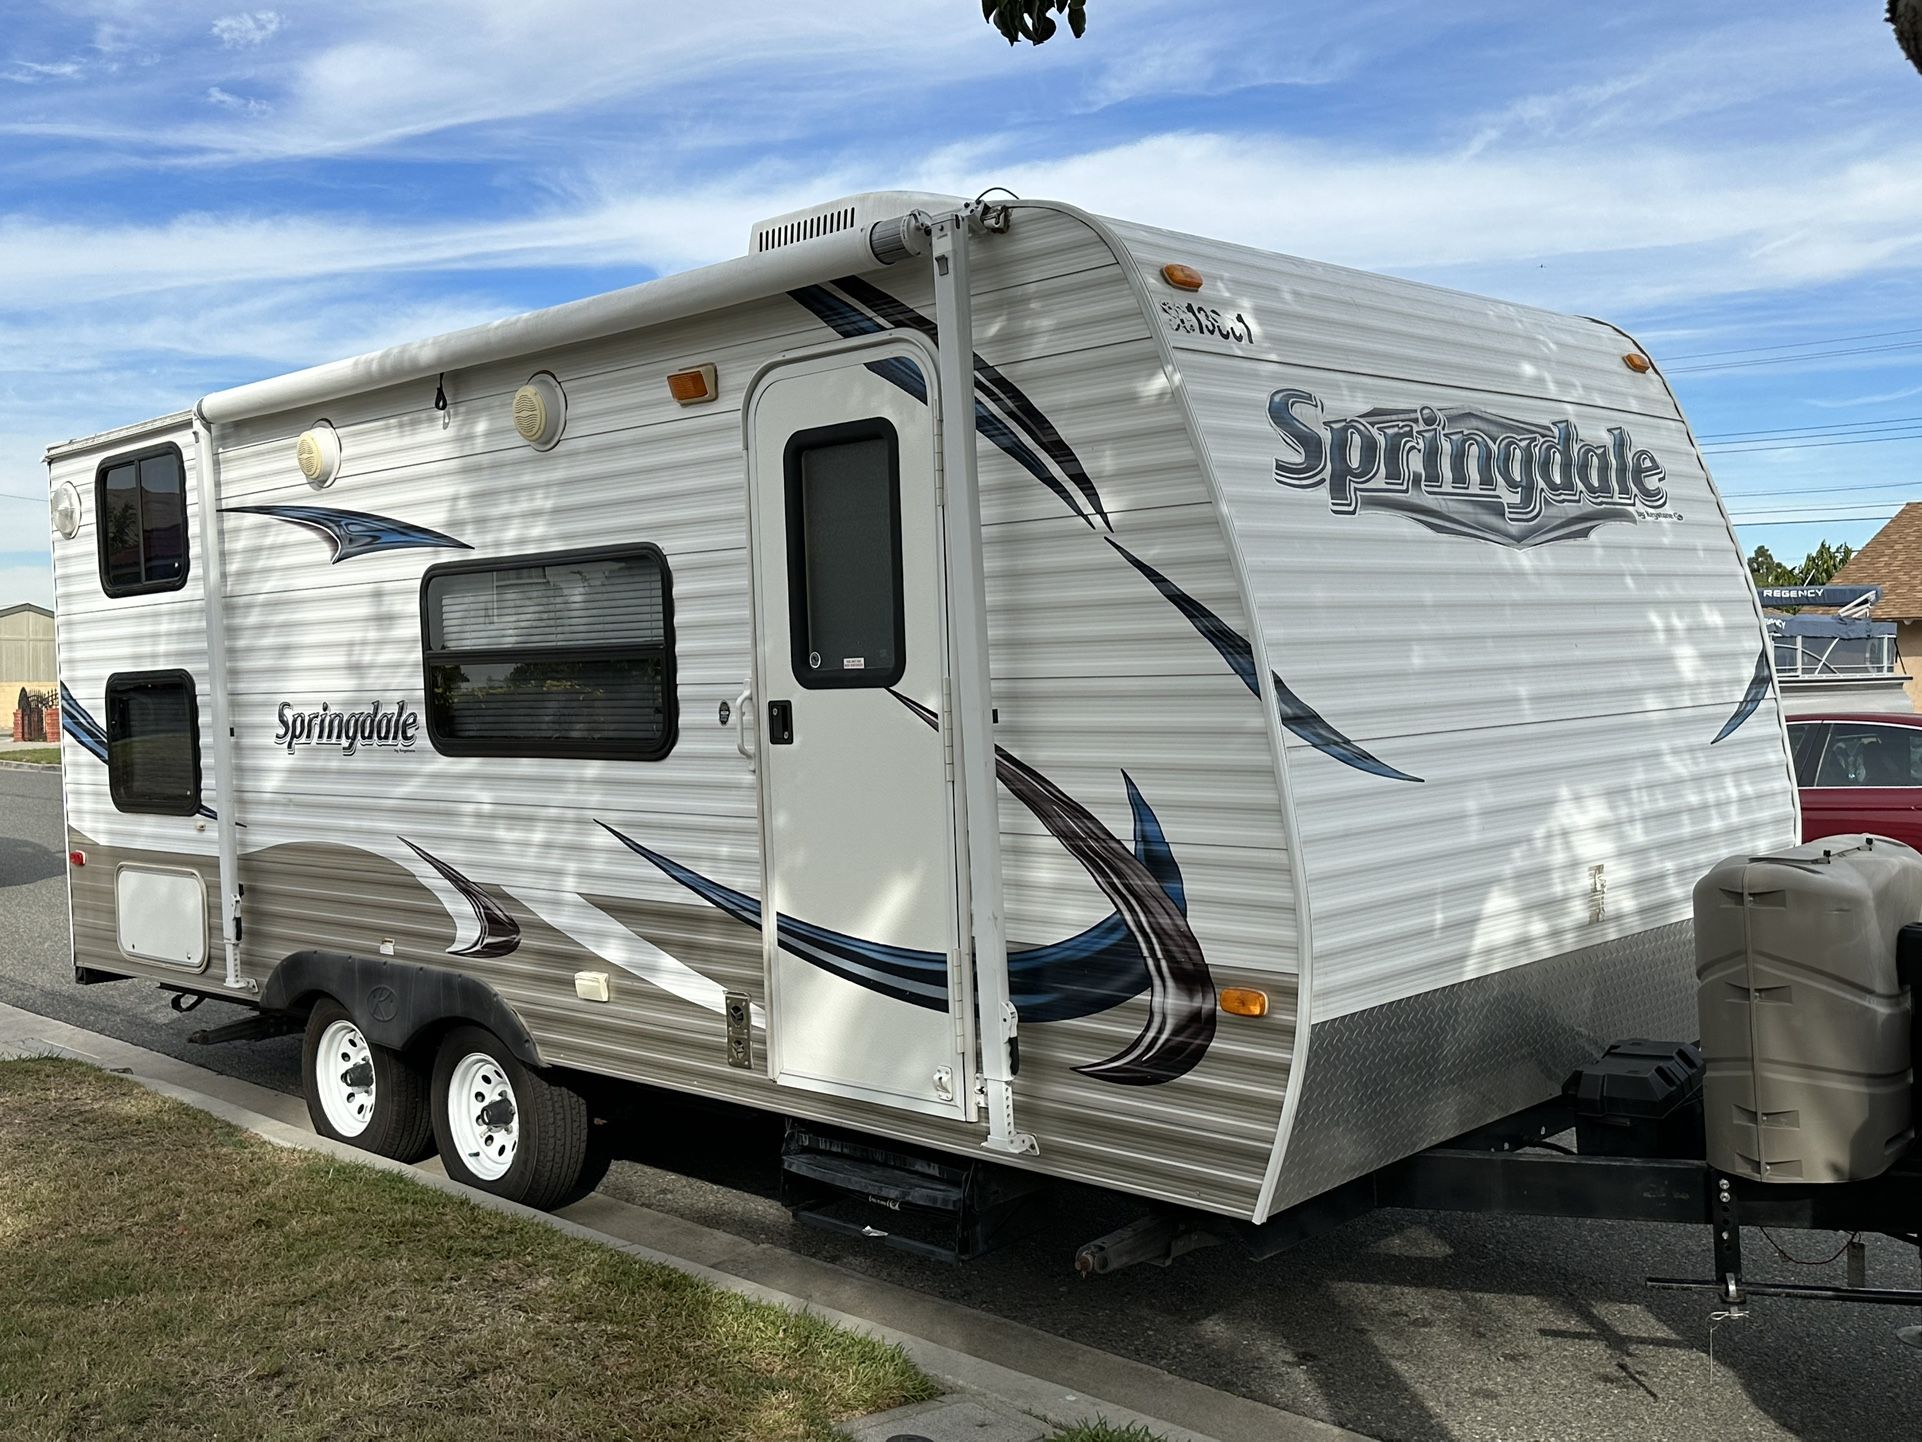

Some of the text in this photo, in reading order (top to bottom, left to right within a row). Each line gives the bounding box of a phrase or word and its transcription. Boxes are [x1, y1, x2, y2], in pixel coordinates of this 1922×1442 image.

[1266, 388, 1668, 523] Springdale
[1763, 588, 1824, 598] REGENCY
[274, 700, 420, 756] Springdale
